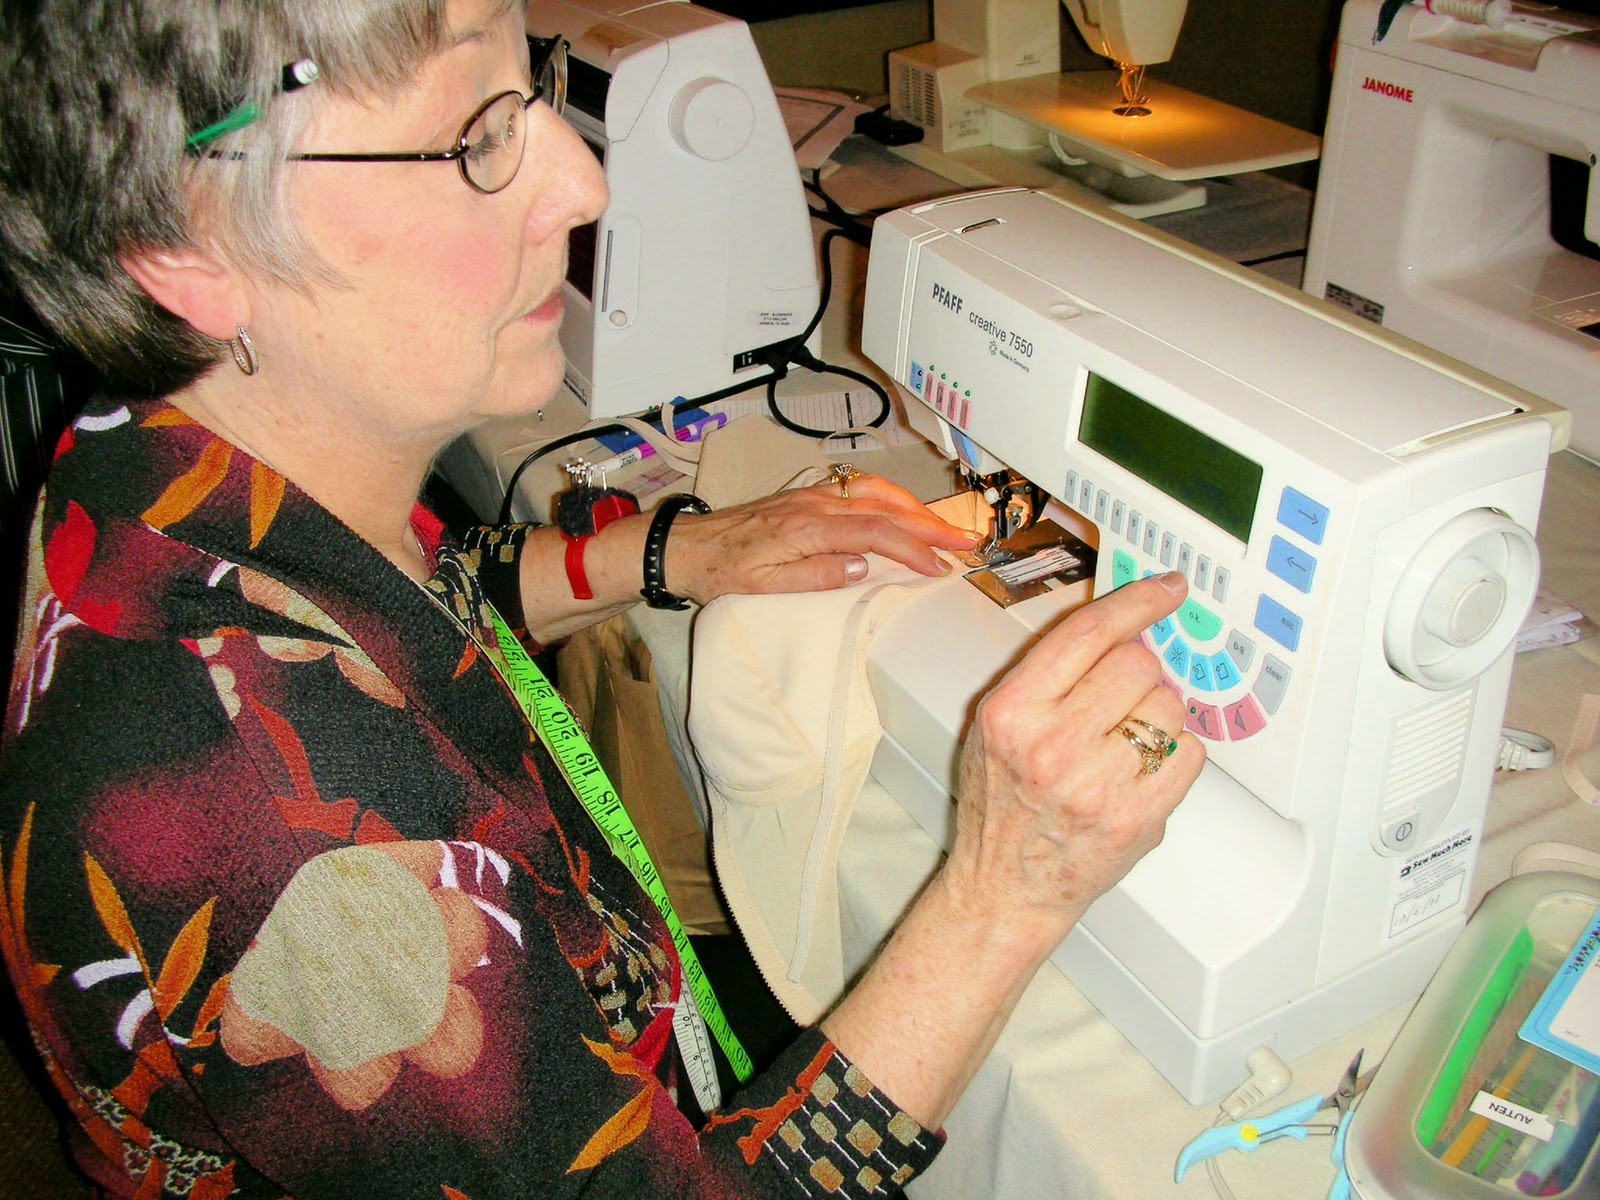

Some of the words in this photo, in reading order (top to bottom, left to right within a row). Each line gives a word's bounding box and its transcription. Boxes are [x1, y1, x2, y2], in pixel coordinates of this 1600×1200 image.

[1361, 77, 1413, 103] JANOME
[932, 282, 963, 314] PFAFF
[968, 311, 1007, 342] creative
[1008, 331, 1034, 358] 7550
[1084, 488, 1089, 496] 2
[1099, 498, 1104, 507] 3
[1115, 508, 1120, 517] 4
[1131, 518, 1136, 527] 5
[1148, 529, 1153, 538] 6
[1165, 540, 1170, 549] 7
[1182, 551, 1187, 560] 8
[1117, 561, 1130, 575] info
[1199, 563, 1205, 572] 9
[1218, 574, 1223, 584] 0
[1281, 617, 1295, 631] esc
[502, 635, 529, 662] 22
[1265, 665, 1284, 682] clear
[530, 677, 555, 699] 21
[551, 711, 580, 740] 20
[574, 751, 601, 778] 19
[596, 790, 622, 816] 18
[617, 829, 641, 850] 17
[1412, 857, 1430, 869] Sew
[641, 861, 658, 888] 16
[658, 895, 673, 921] 15
[674, 927, 689, 952] 14
[688, 959, 704, 983] 13
[704, 989, 718, 1013] 12
[682, 1015, 692, 1027] 10
[721, 1020, 732, 1043] 11
[735, 1046, 749, 1071] 10
[1488, 1102, 1534, 1125] AUTEN
